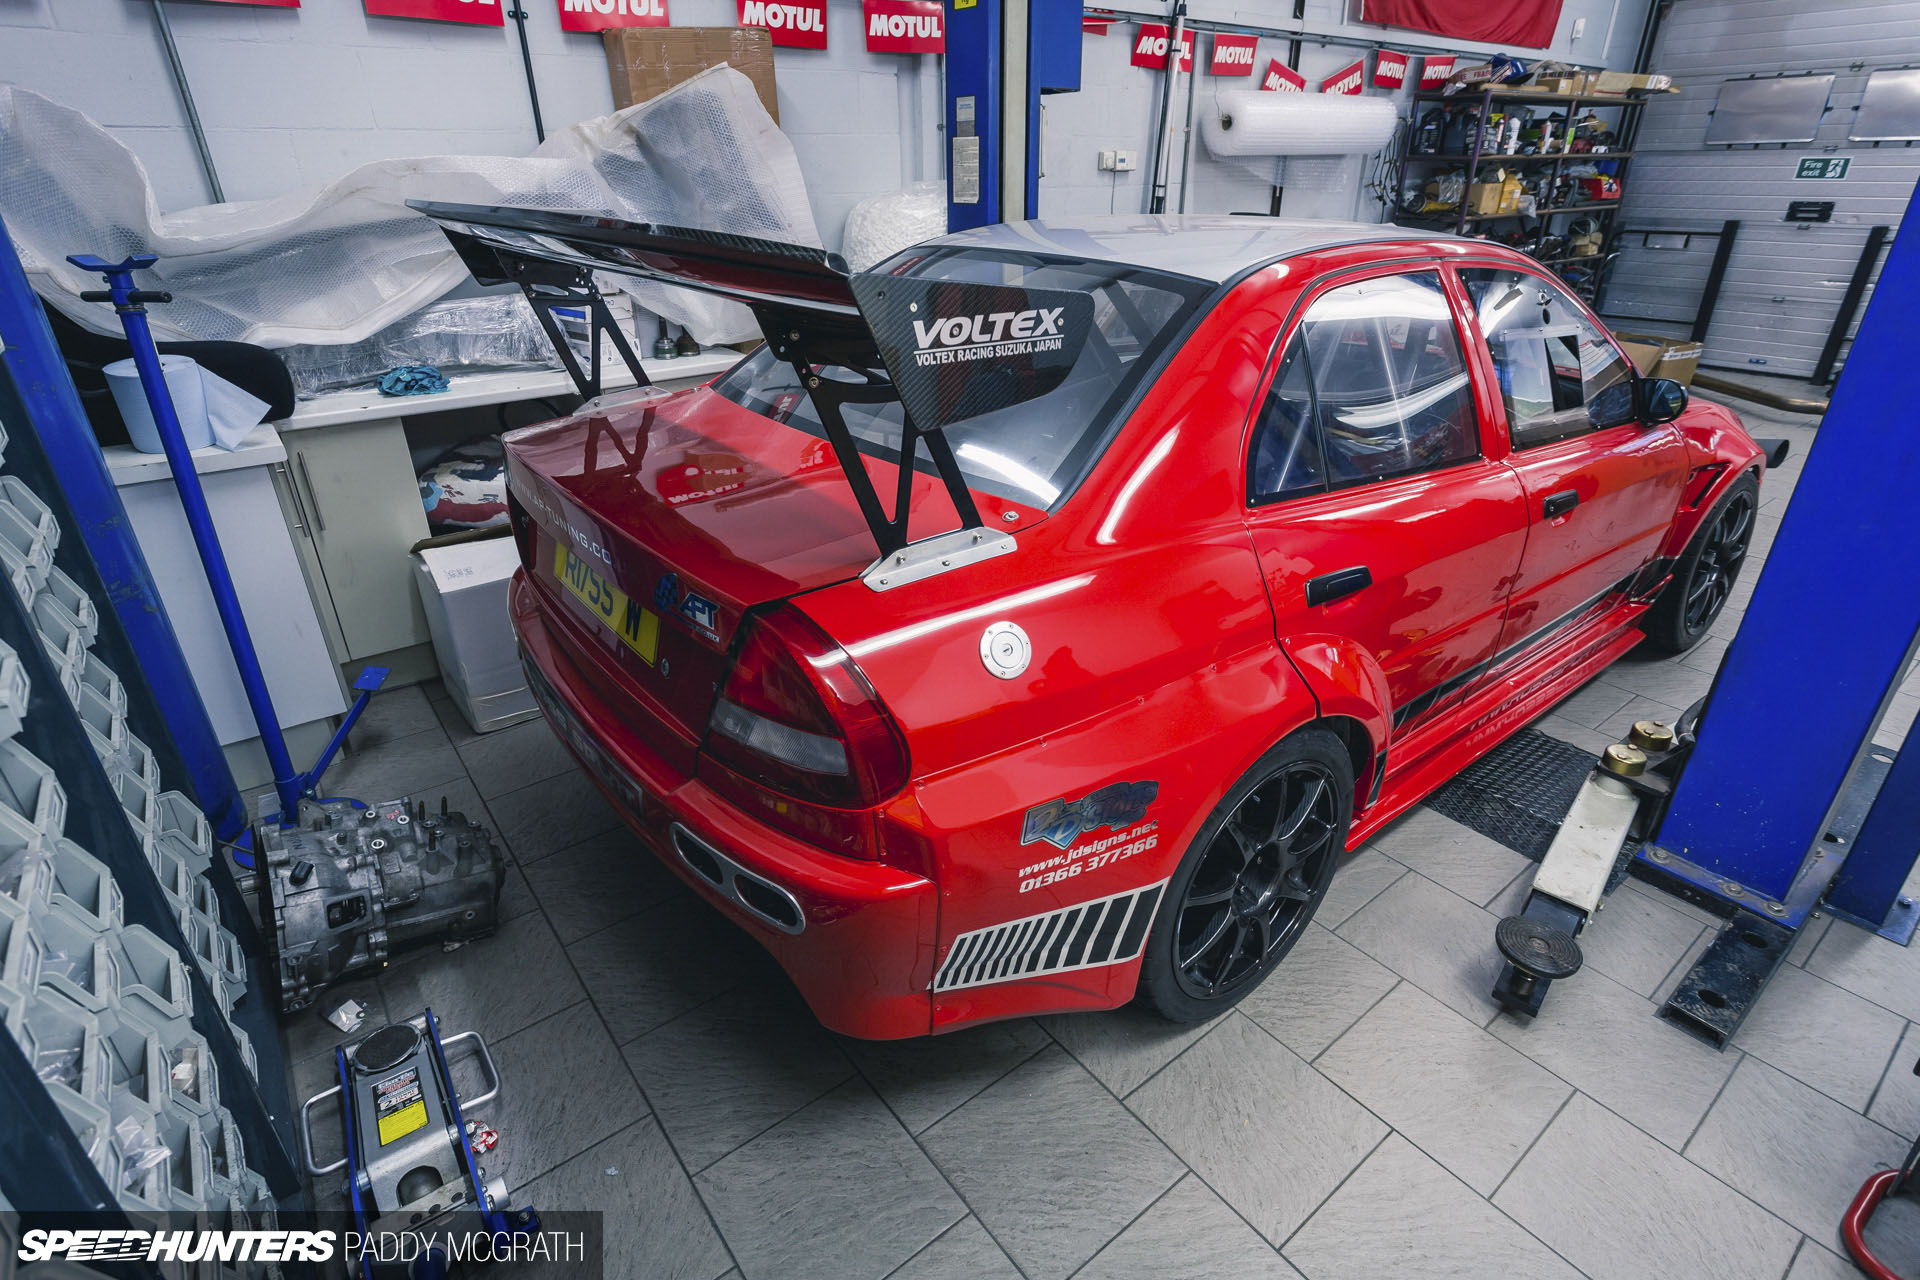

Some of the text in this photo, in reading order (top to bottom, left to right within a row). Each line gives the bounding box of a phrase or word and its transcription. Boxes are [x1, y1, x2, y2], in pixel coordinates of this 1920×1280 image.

[743, 0, 824, 33] MOTUL
[869, 13, 942, 38] MOTUL
[1136, 36, 1192, 60] MOUL
[1214, 45, 1254, 64] MOTUL
[1376, 59, 1405, 79] MOTUL
[1423, 65, 1452, 80] MOTUL
[1801, 169, 1821, 177] exit
[1803, 160, 1824, 169] Fire
[912, 307, 1065, 349] VOLTEX
[916, 338, 1062, 367] VOLTEX RACING SUZUKA JAPAN
[1018, 819, 1159, 878] www.jdsigns.net
[1019, 834, 1159, 894] 01366 377366
